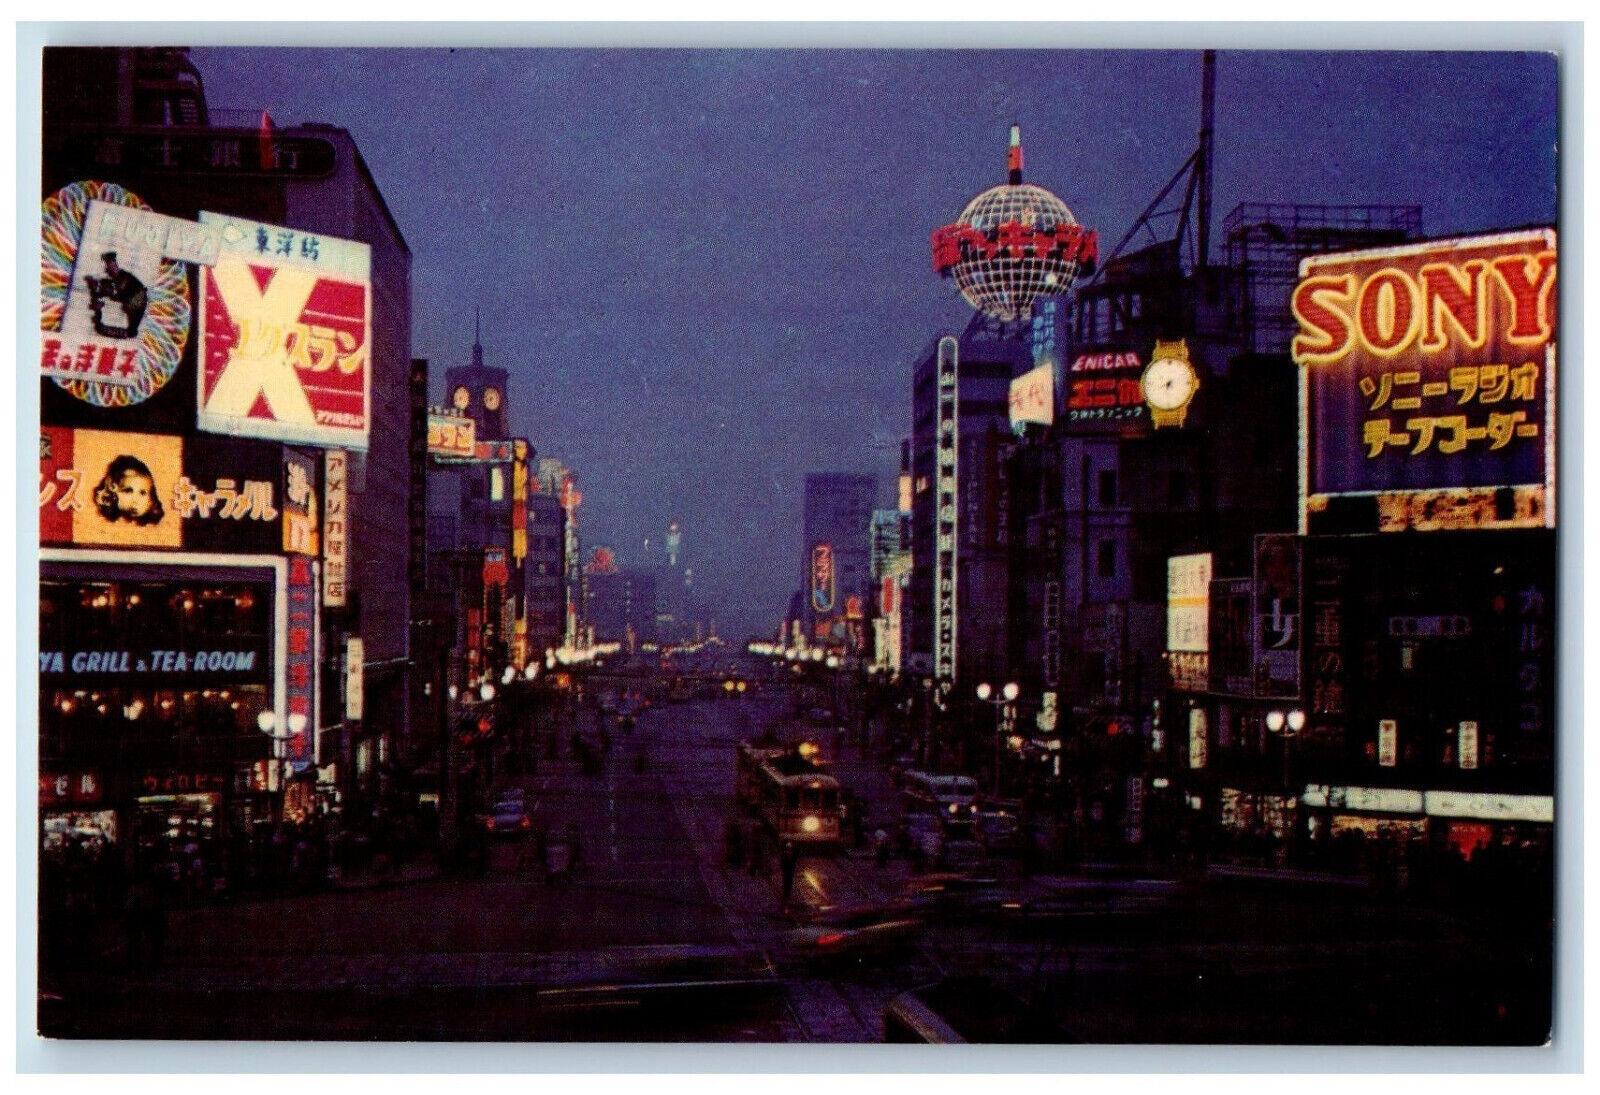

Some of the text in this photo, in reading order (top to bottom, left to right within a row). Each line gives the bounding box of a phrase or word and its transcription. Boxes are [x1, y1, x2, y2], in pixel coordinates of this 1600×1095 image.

[1292, 251, 1556, 364] SONY
[1071, 352, 1142, 371] ENICAR
[1359, 362, 1539, 411] ソニーラジオ
[172, 476, 278, 521] キャラメル
[72, 652, 130, 673] GRILL
[150, 651, 255, 672] TEA-ROOM
